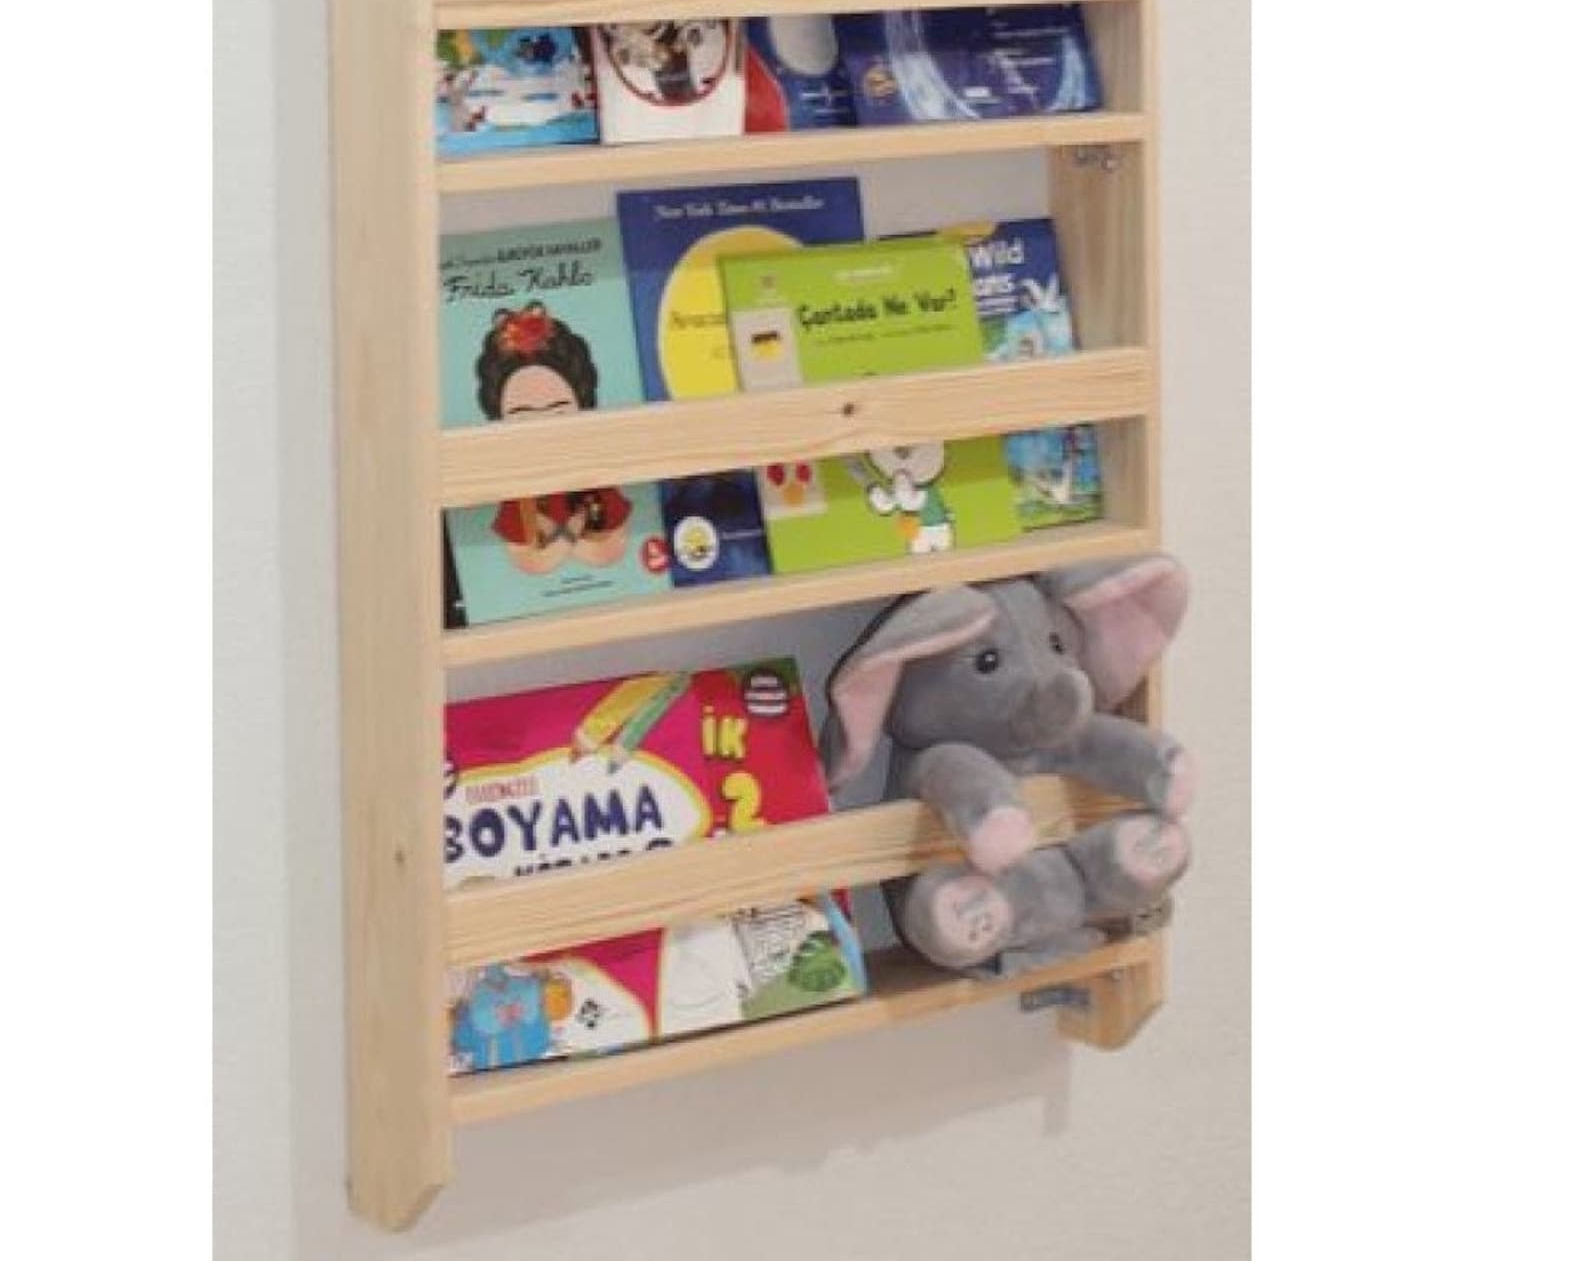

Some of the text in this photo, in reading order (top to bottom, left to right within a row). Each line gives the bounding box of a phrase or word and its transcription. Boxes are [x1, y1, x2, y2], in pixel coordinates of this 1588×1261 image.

[968, 235, 1026, 269] Wild
[442, 269, 517, 302] Frida
[519, 258, 595, 293] Kahlo
[797, 297, 878, 333] Çantada
[881, 291, 909, 316] Ne
[912, 286, 957, 315] Var?
